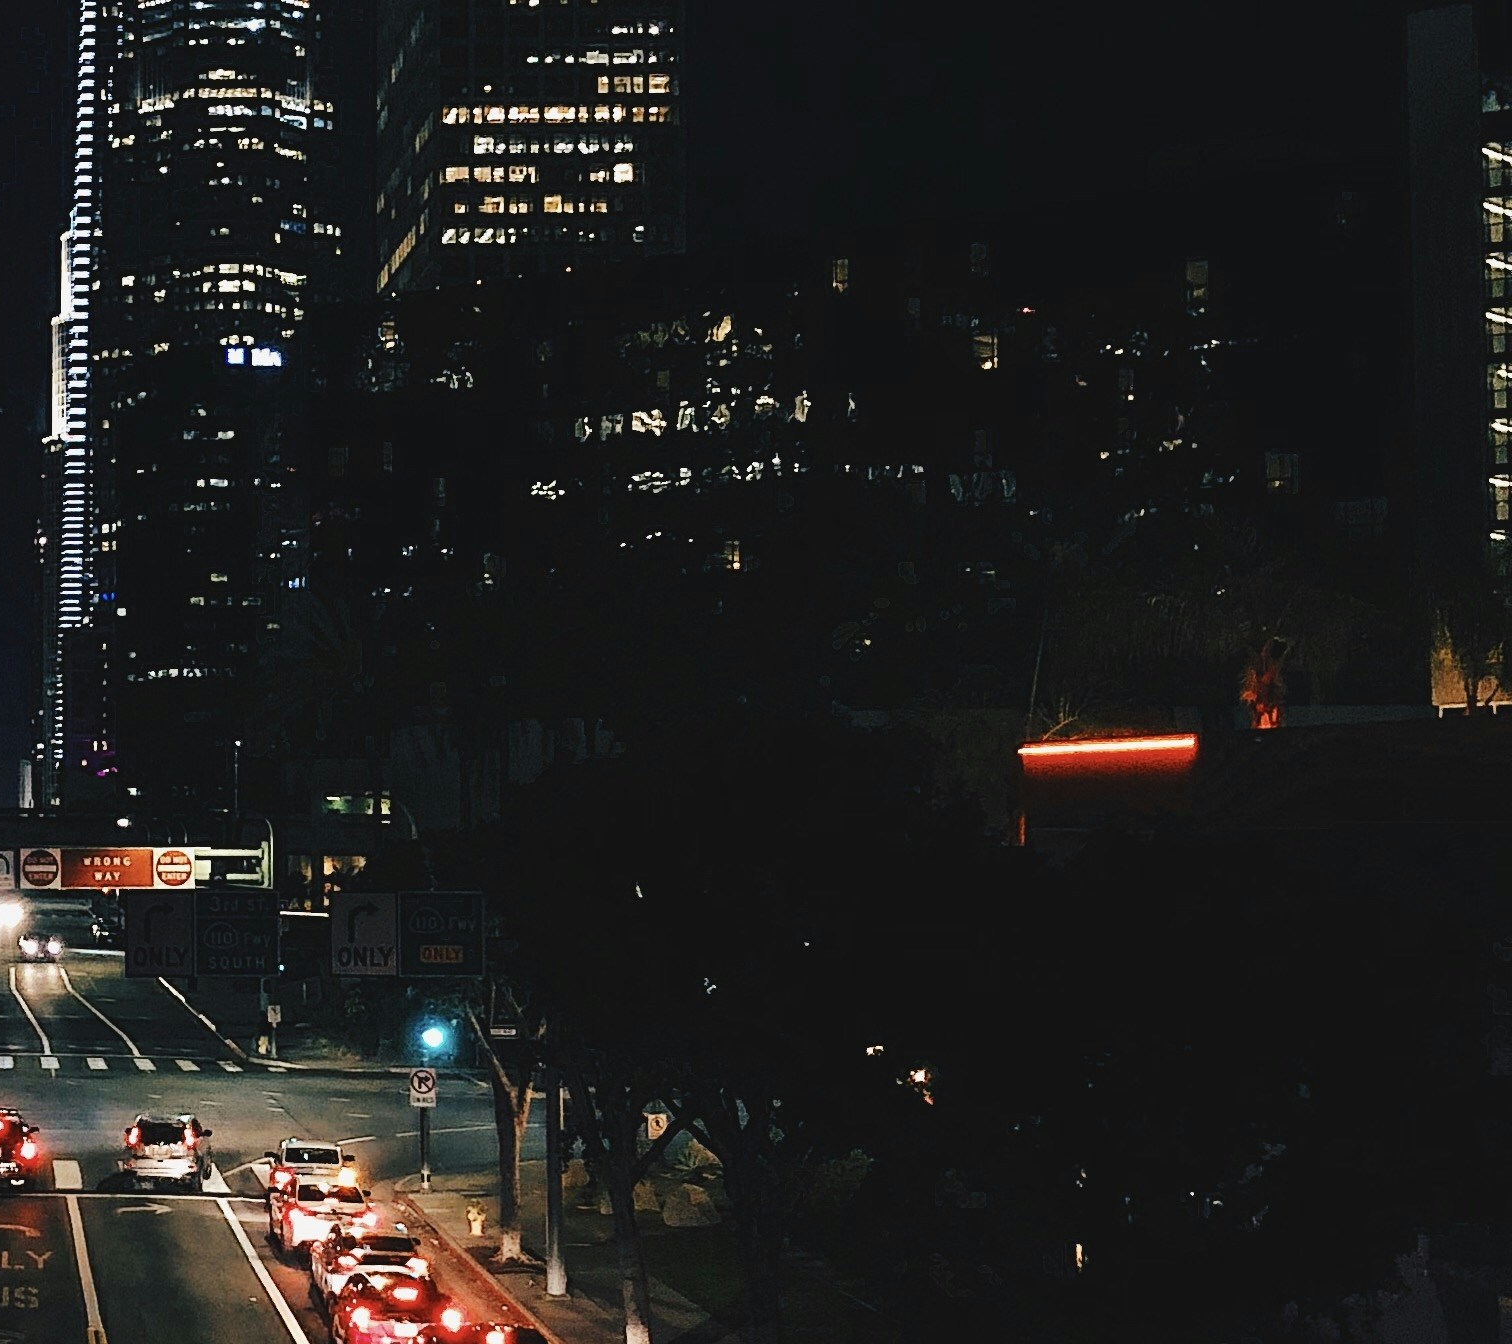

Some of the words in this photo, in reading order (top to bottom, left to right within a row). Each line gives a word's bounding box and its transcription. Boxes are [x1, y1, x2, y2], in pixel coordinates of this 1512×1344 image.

[82, 856, 132, 867] WRONG
[93, 871, 121, 881] WAY
[209, 895, 238, 912] 3rd
[415, 917, 438, 929] 110
[447, 917, 476, 932] Fwy
[210, 932, 233, 945] 110
[243, 932, 271, 948] Fwy
[133, 945, 188, 968] ONLY
[337, 945, 394, 968] ONLY
[421, 947, 463, 960] ONLY
[208, 957, 266, 970] SOUTH
